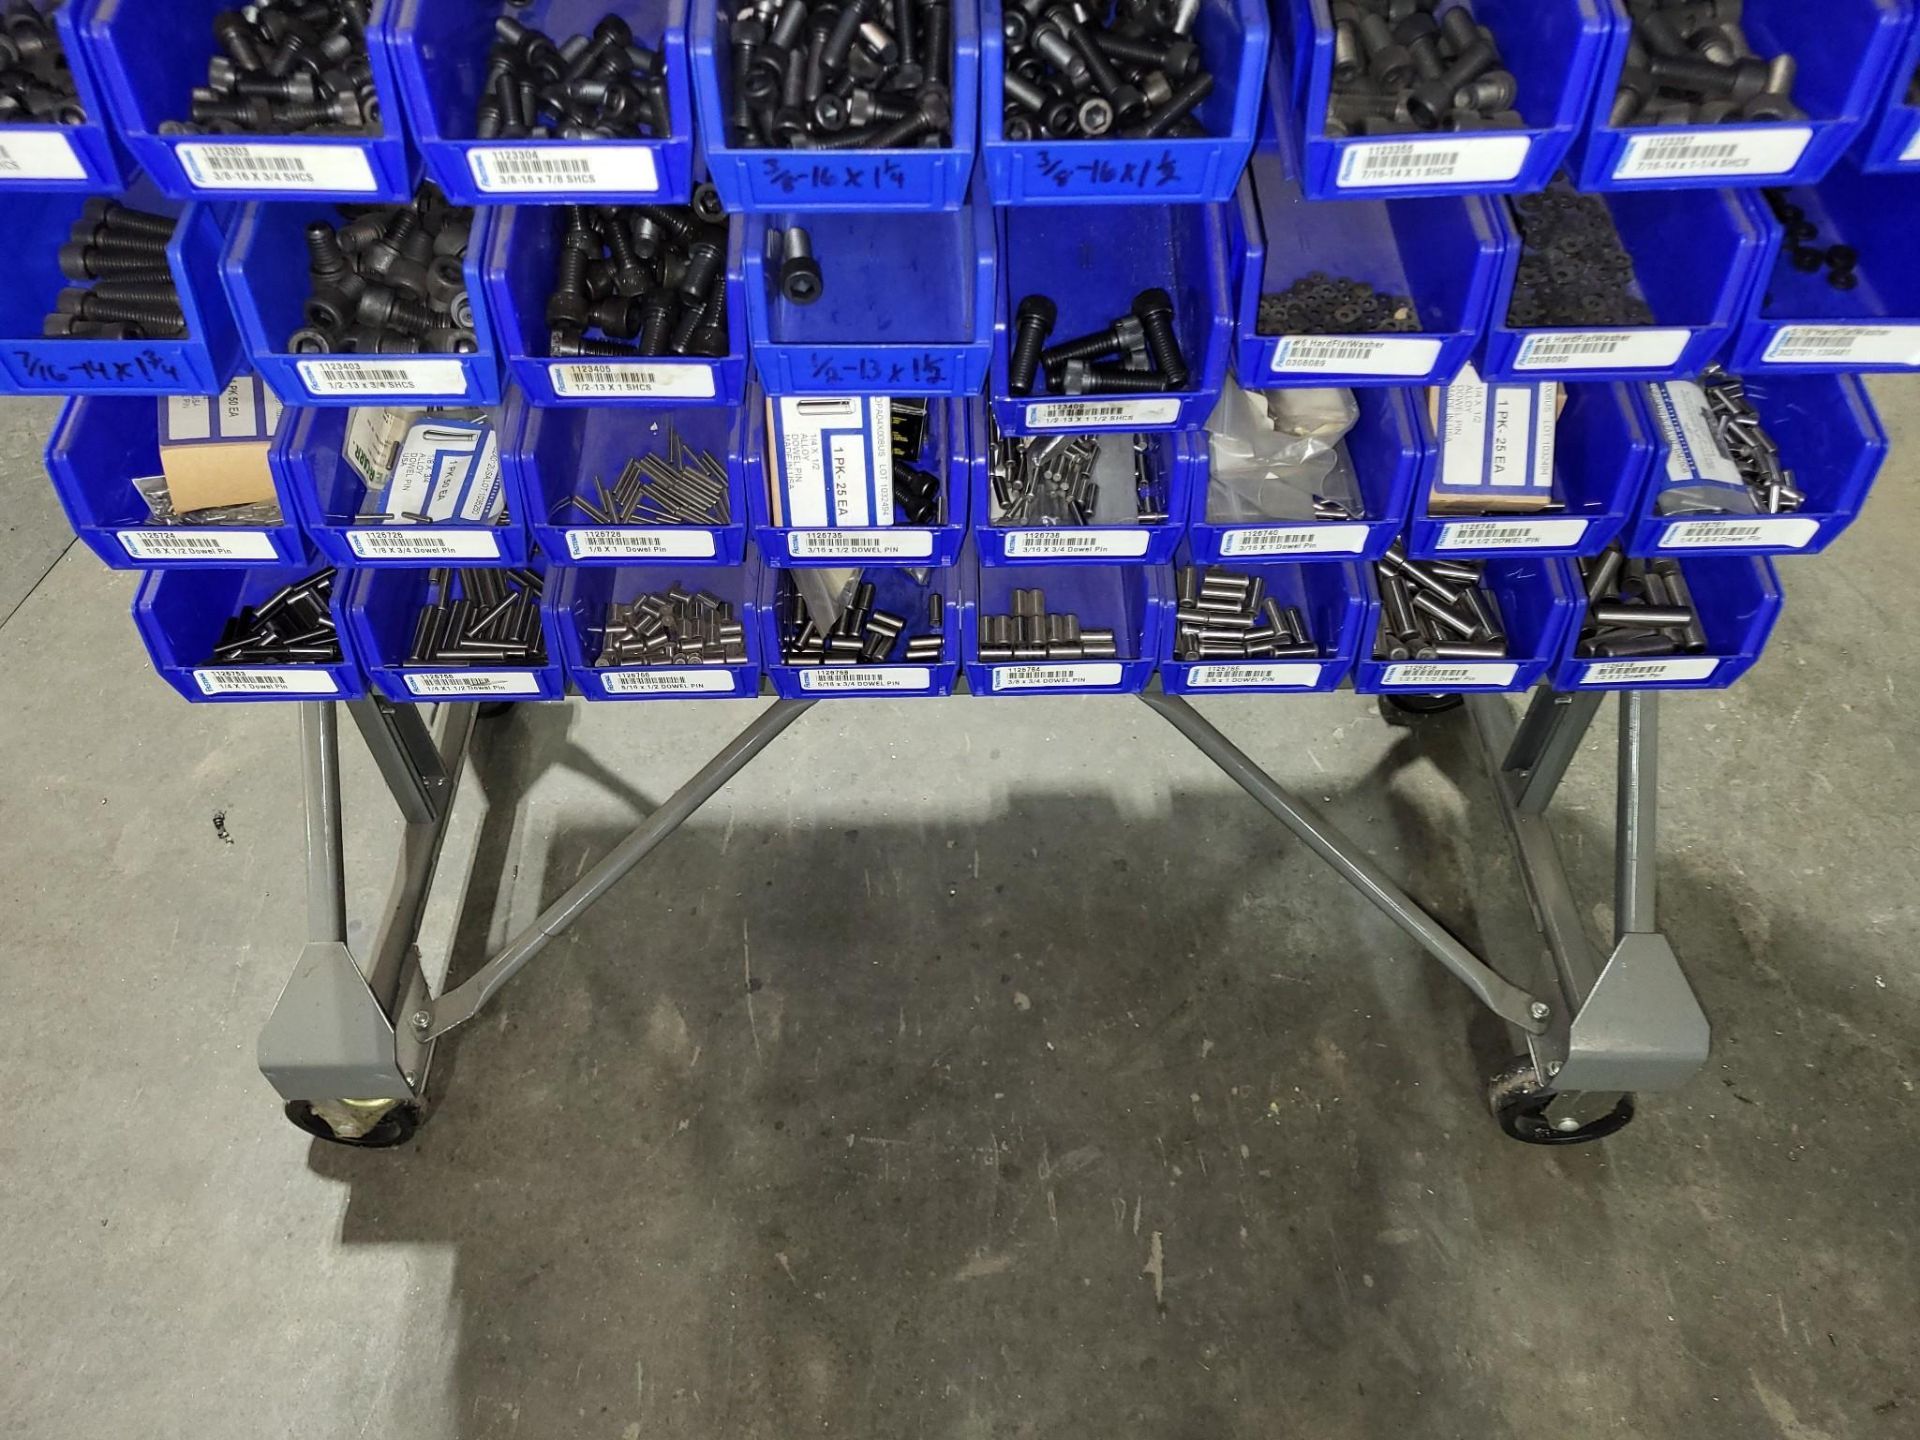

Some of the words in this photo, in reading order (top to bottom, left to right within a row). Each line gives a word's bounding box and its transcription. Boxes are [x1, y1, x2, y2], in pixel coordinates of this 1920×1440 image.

[285, 172, 314, 183] SHCS
[567, 174, 597, 184] SHCS
[318, 362, 361, 371] 1123403
[388, 380, 416, 390] SHCS
[626, 383, 653, 392] SHCS
[1494, 456, 1506, 474] EA
[836, 482, 848, 497] 25
[838, 500, 850, 516] EA
[851, 546, 881, 554] DOWEL
[884, 546, 899, 554] PIN
